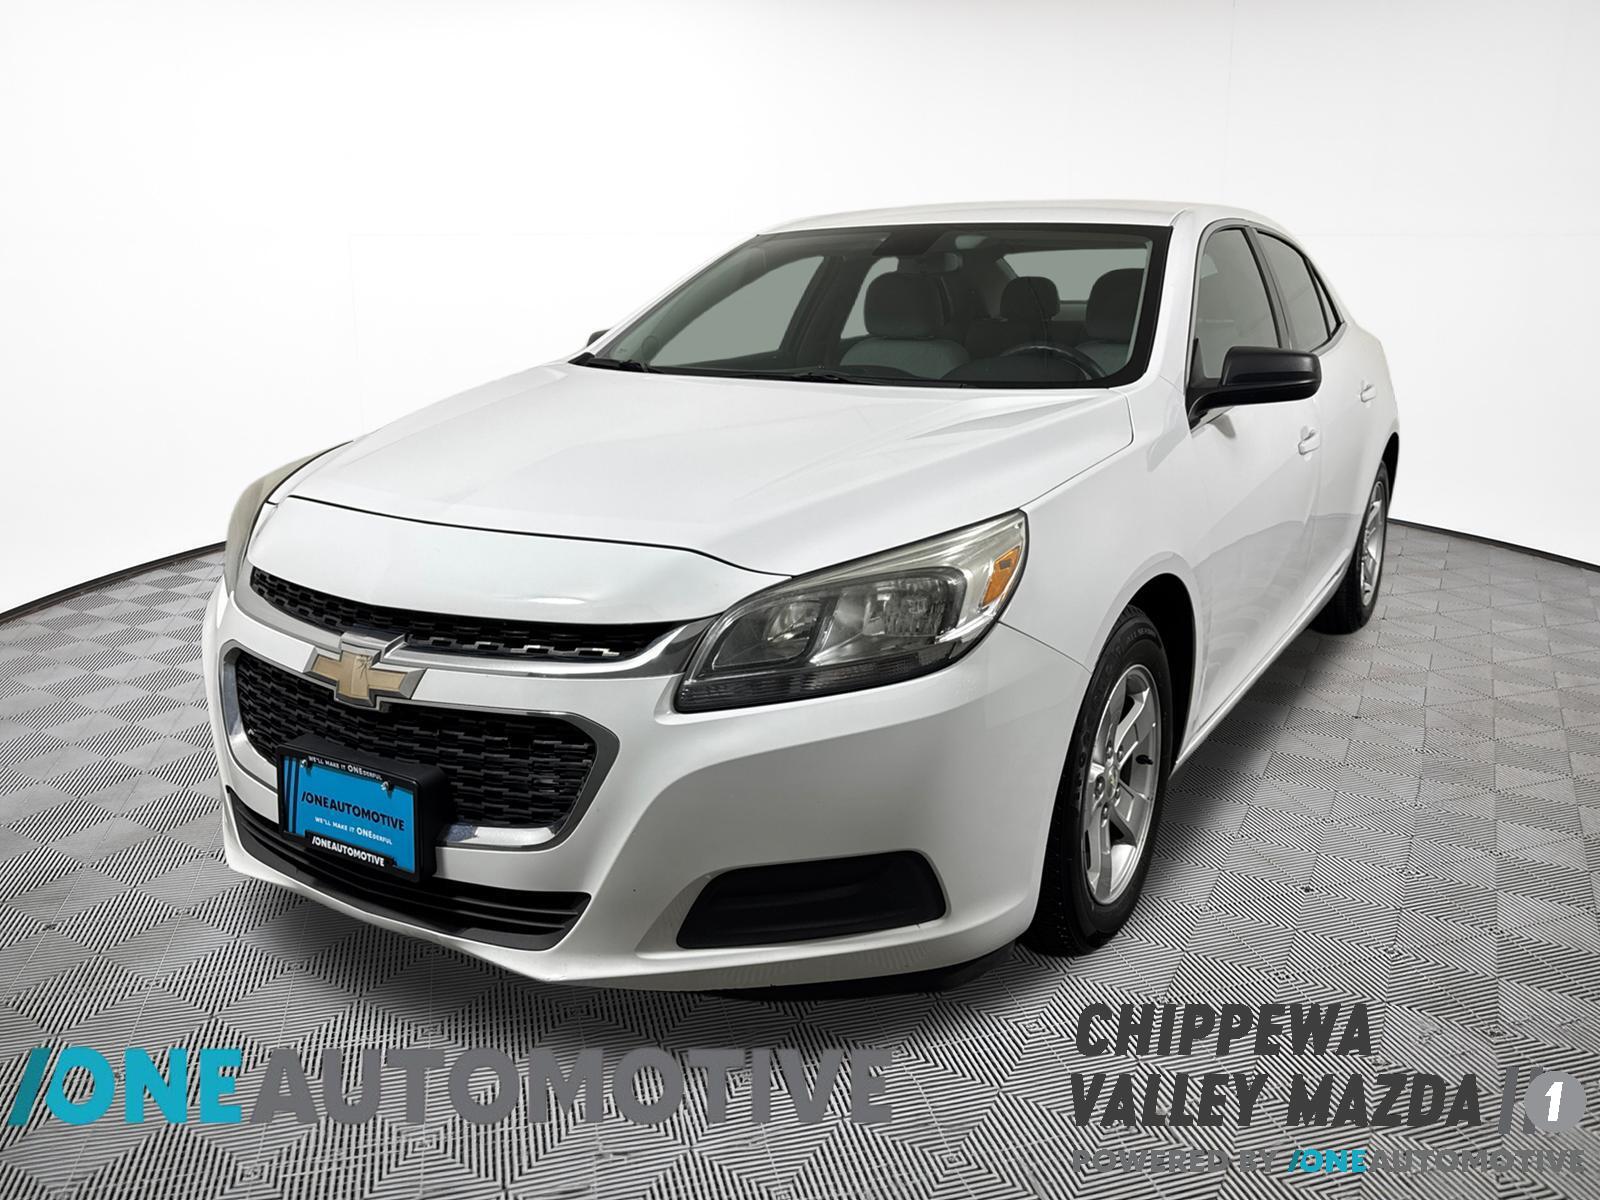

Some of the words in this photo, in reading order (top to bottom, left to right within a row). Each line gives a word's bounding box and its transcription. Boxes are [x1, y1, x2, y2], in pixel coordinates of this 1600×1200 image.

[324, 759, 340, 769] MAKE
[314, 816, 331, 826] WE'LL
[332, 821, 348, 831] MAKE
